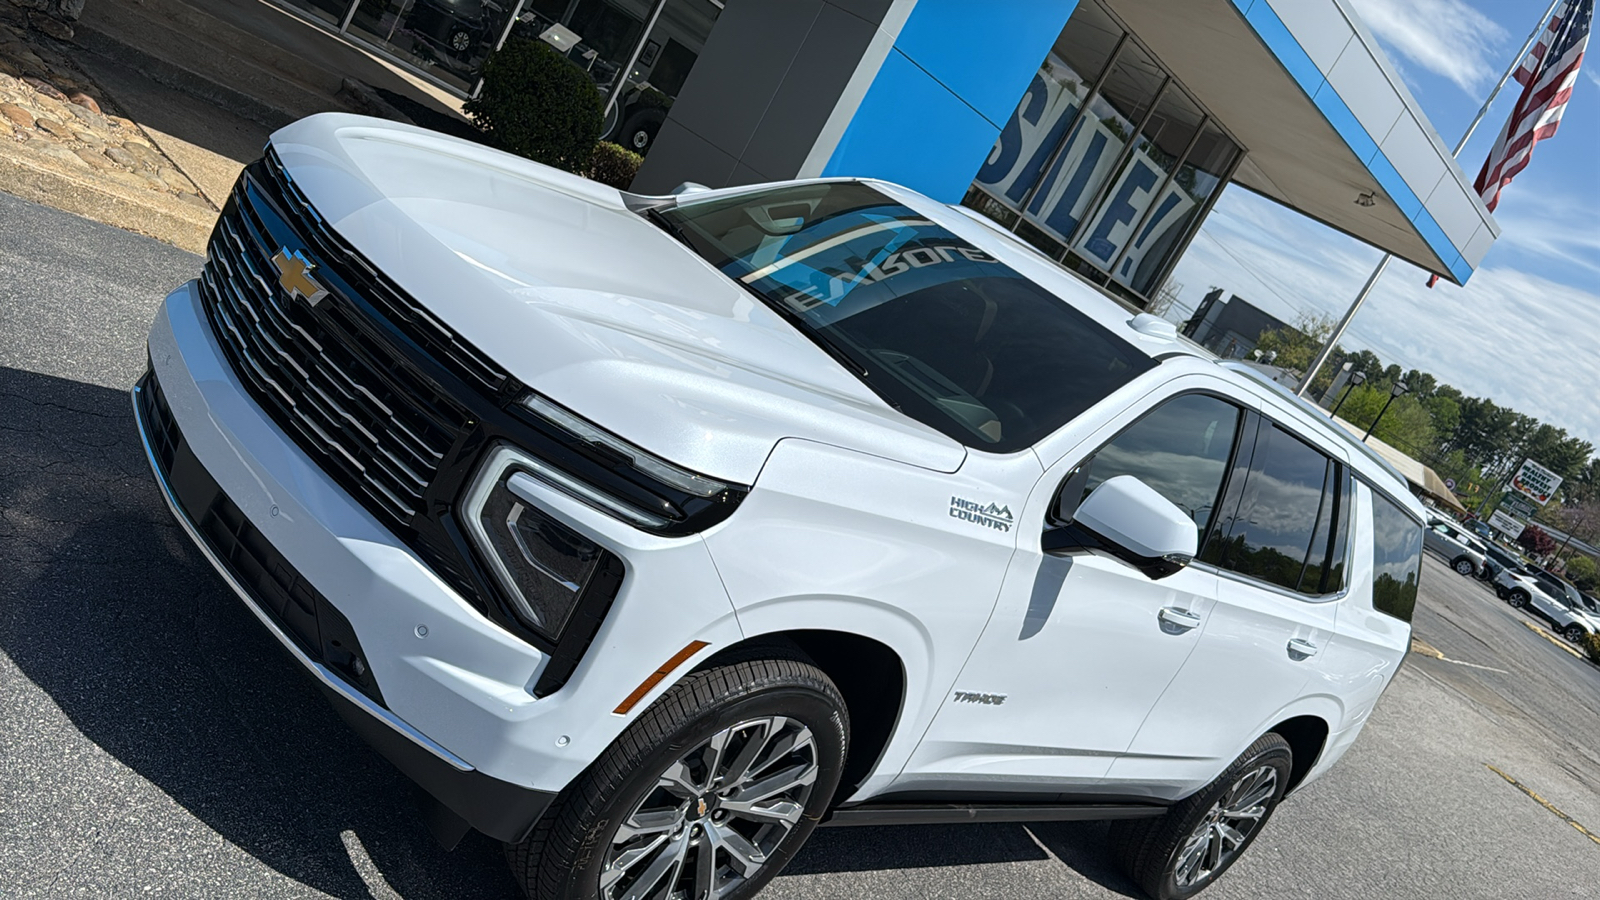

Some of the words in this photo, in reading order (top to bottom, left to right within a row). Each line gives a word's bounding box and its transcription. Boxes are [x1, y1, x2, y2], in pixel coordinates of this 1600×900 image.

[976, 73, 1182, 277] SALE!
[1521, 471, 1552, 491] HARVEST
[1522, 464, 1552, 483] HEALTHY
[1520, 477, 1552, 498] PRODUCE
[951, 496, 985, 513] HIGH
[949, 507, 1012, 532] COUNTRY
[953, 691, 1007, 705] TAHOE
